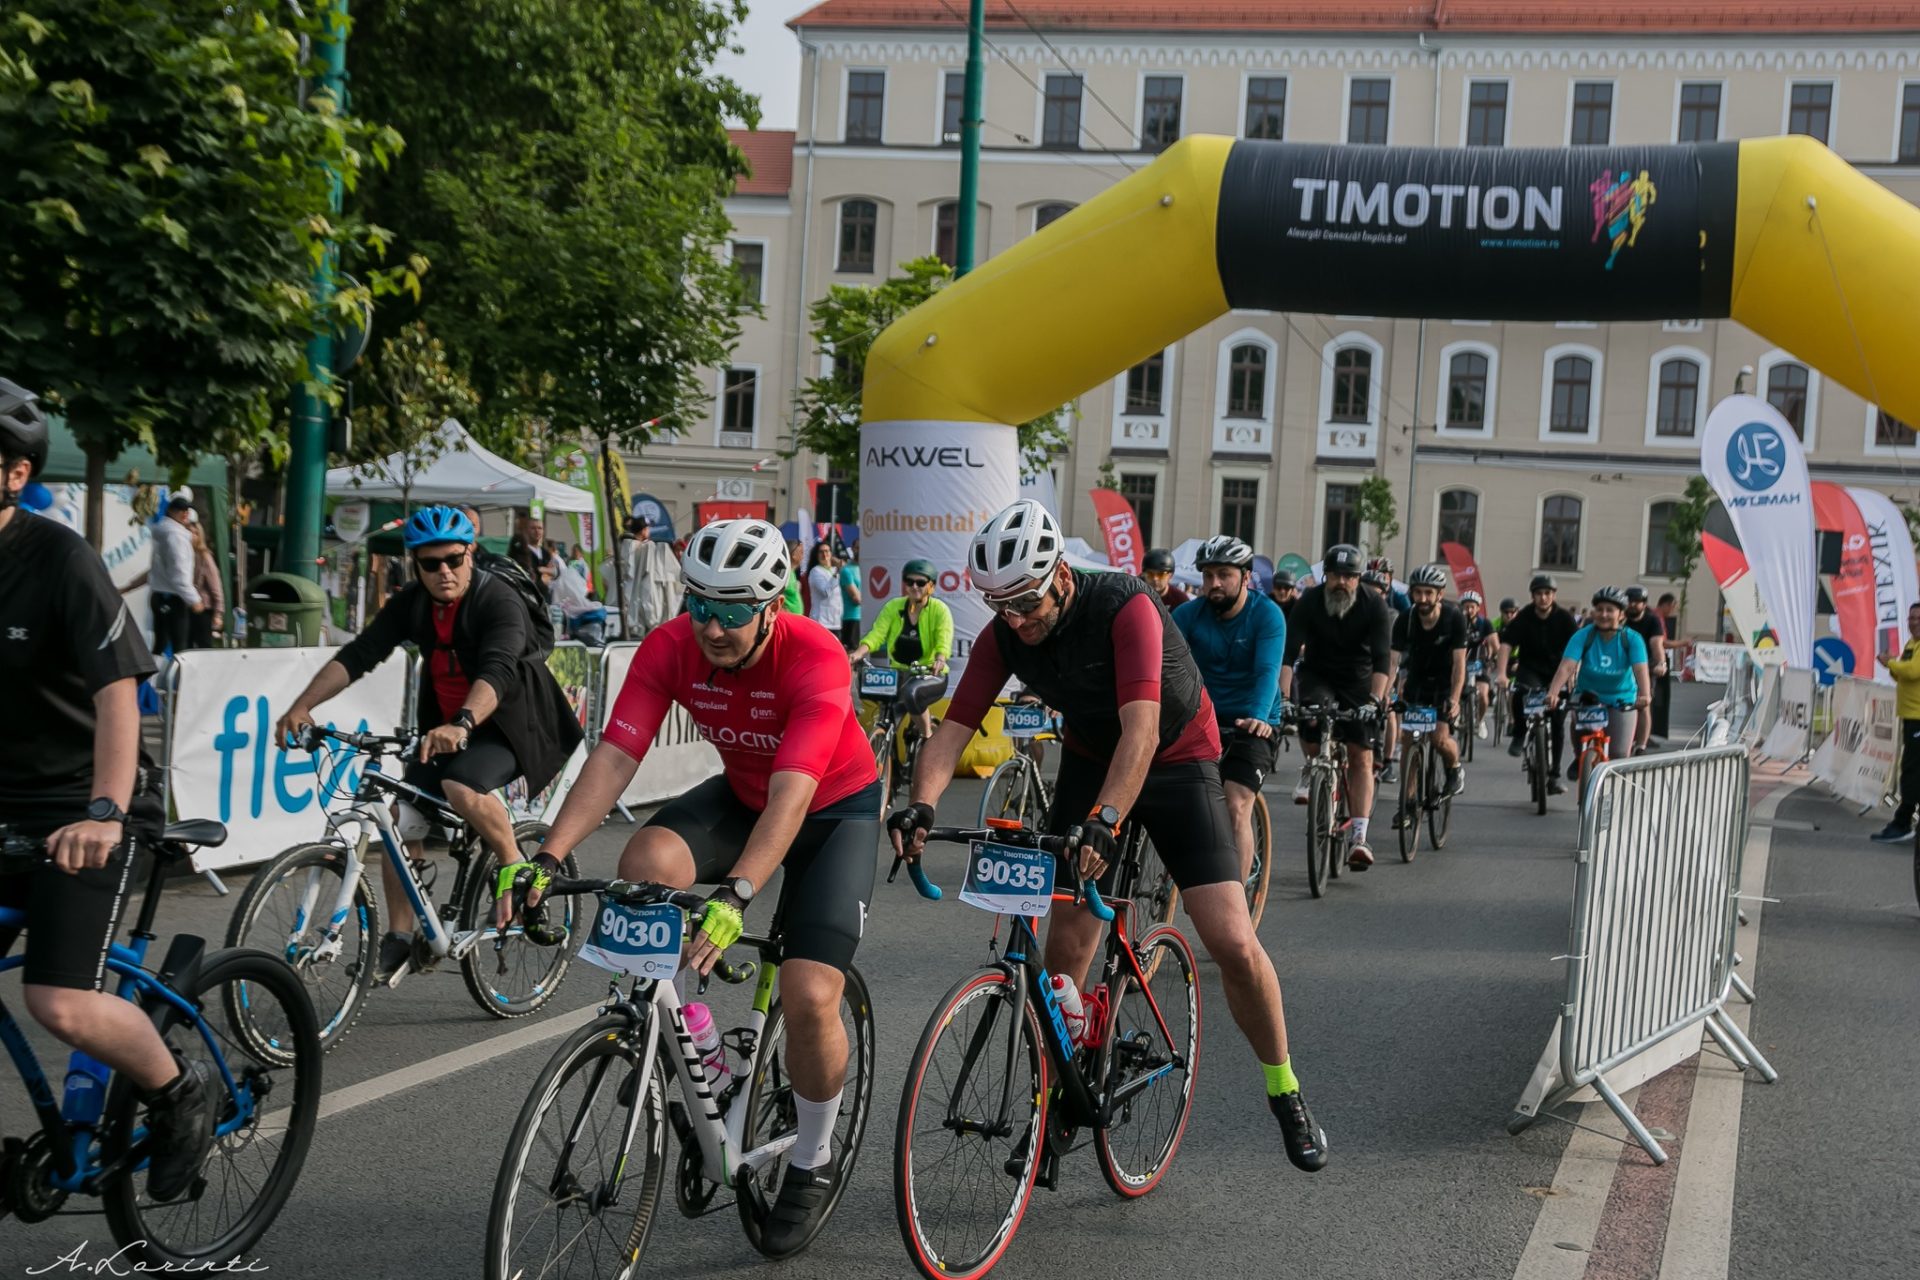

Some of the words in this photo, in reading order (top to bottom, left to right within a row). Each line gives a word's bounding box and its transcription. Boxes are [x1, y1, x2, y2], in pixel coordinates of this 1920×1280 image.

[1292, 177, 1563, 231] TIMOTION
[866, 446, 985, 468] AKWEL
[863, 508, 976, 537] Continental
[865, 672, 894, 685] 9010
[1007, 712, 1040, 727] 9098
[1003, 850, 1034, 860] TIMOTION
[976, 857, 1046, 890] 9035
[600, 907, 671, 948] 9030
[1038, 967, 1076, 1062] CUBE
[668, 1007, 722, 1121] SCOTT
